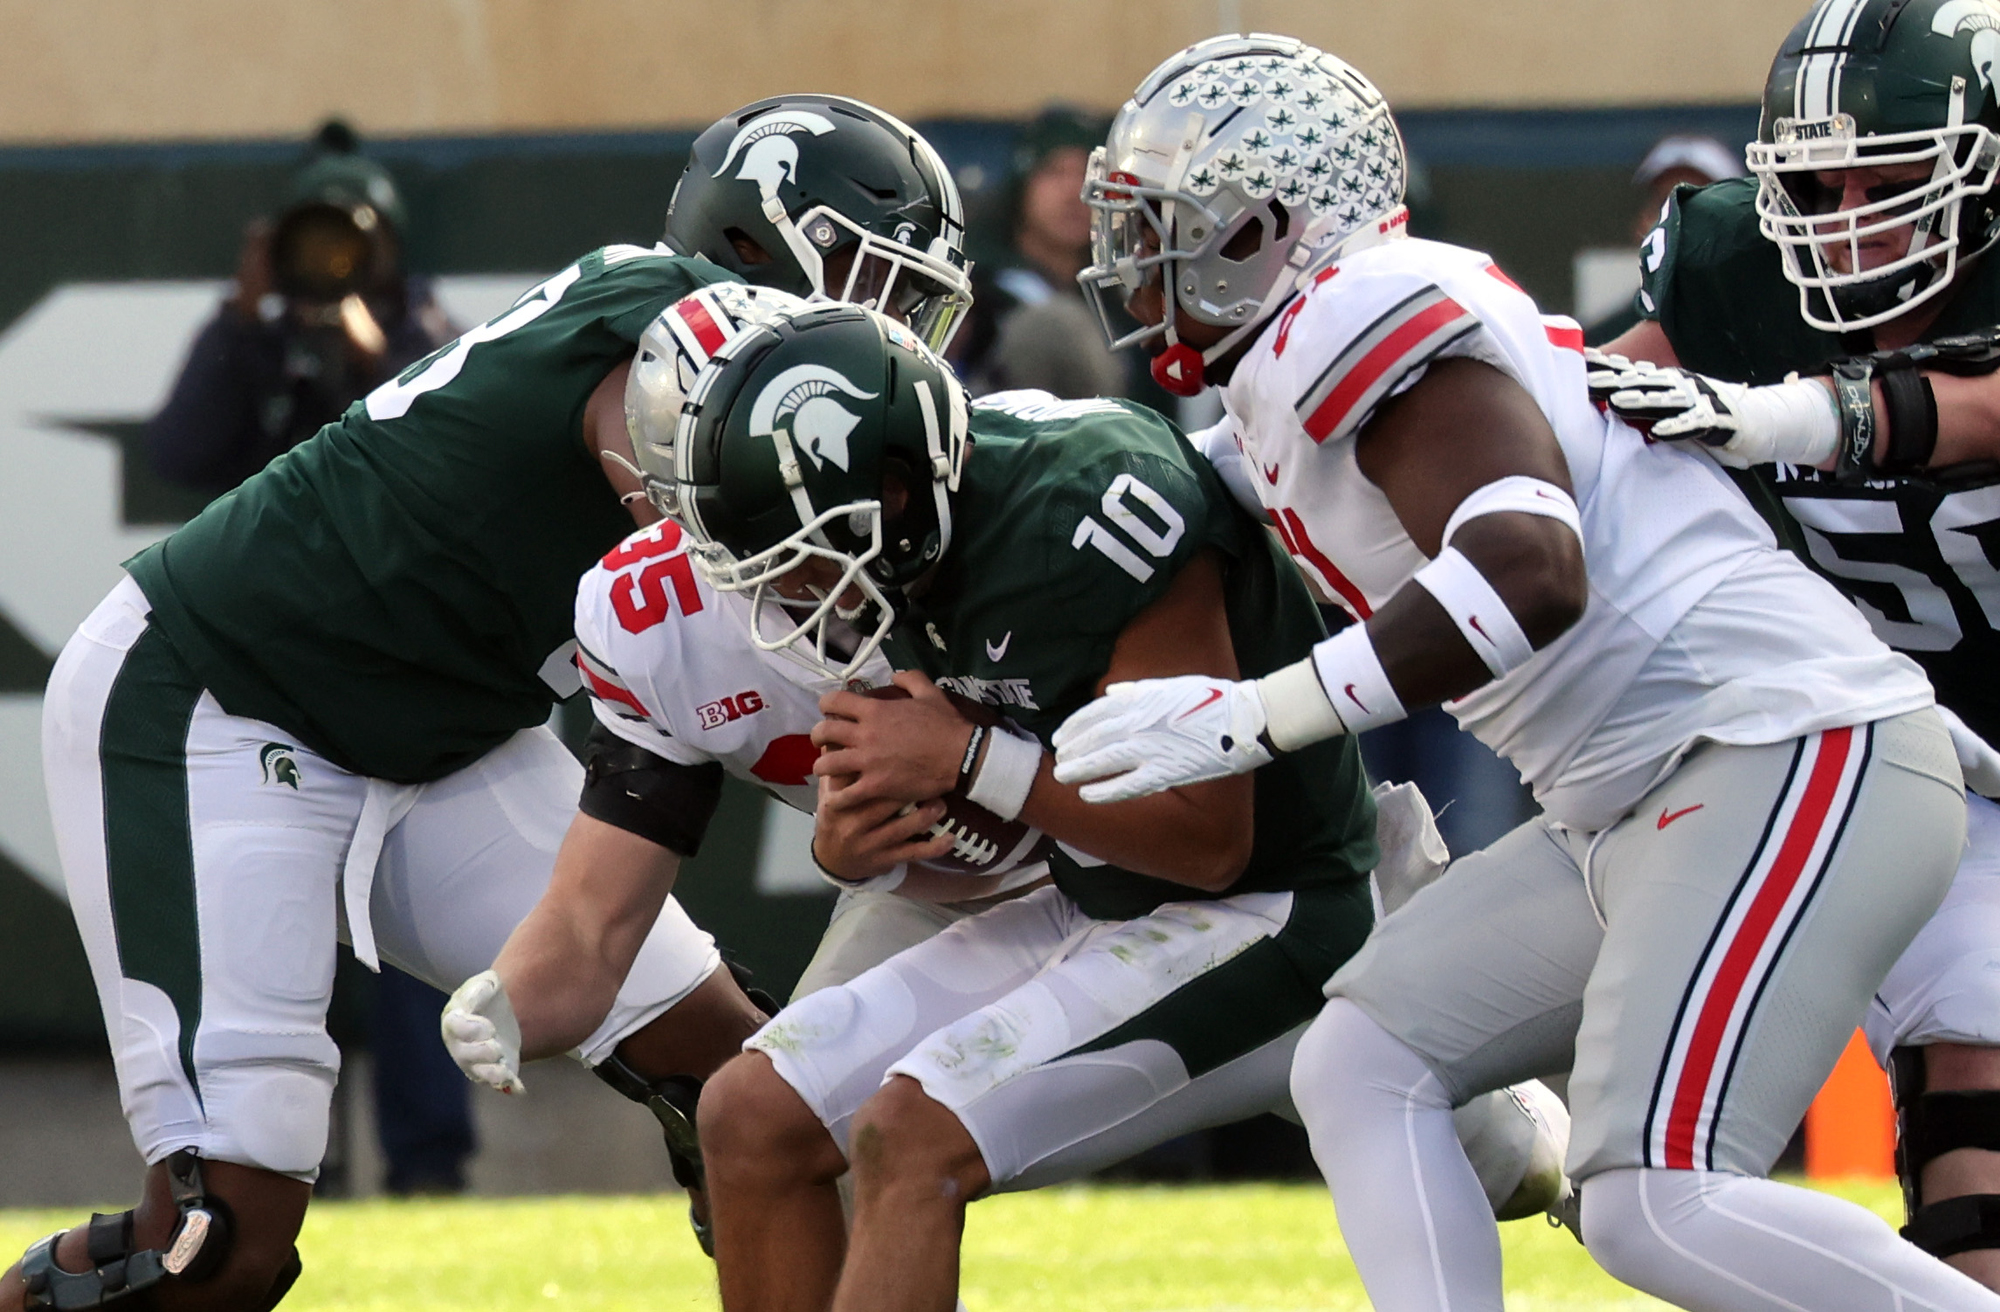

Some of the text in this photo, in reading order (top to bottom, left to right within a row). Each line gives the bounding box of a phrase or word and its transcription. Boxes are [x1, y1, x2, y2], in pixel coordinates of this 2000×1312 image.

[1795, 121, 1833, 140] STATE
[602, 518, 704, 635] 35
[1071, 473, 1186, 584] 10
